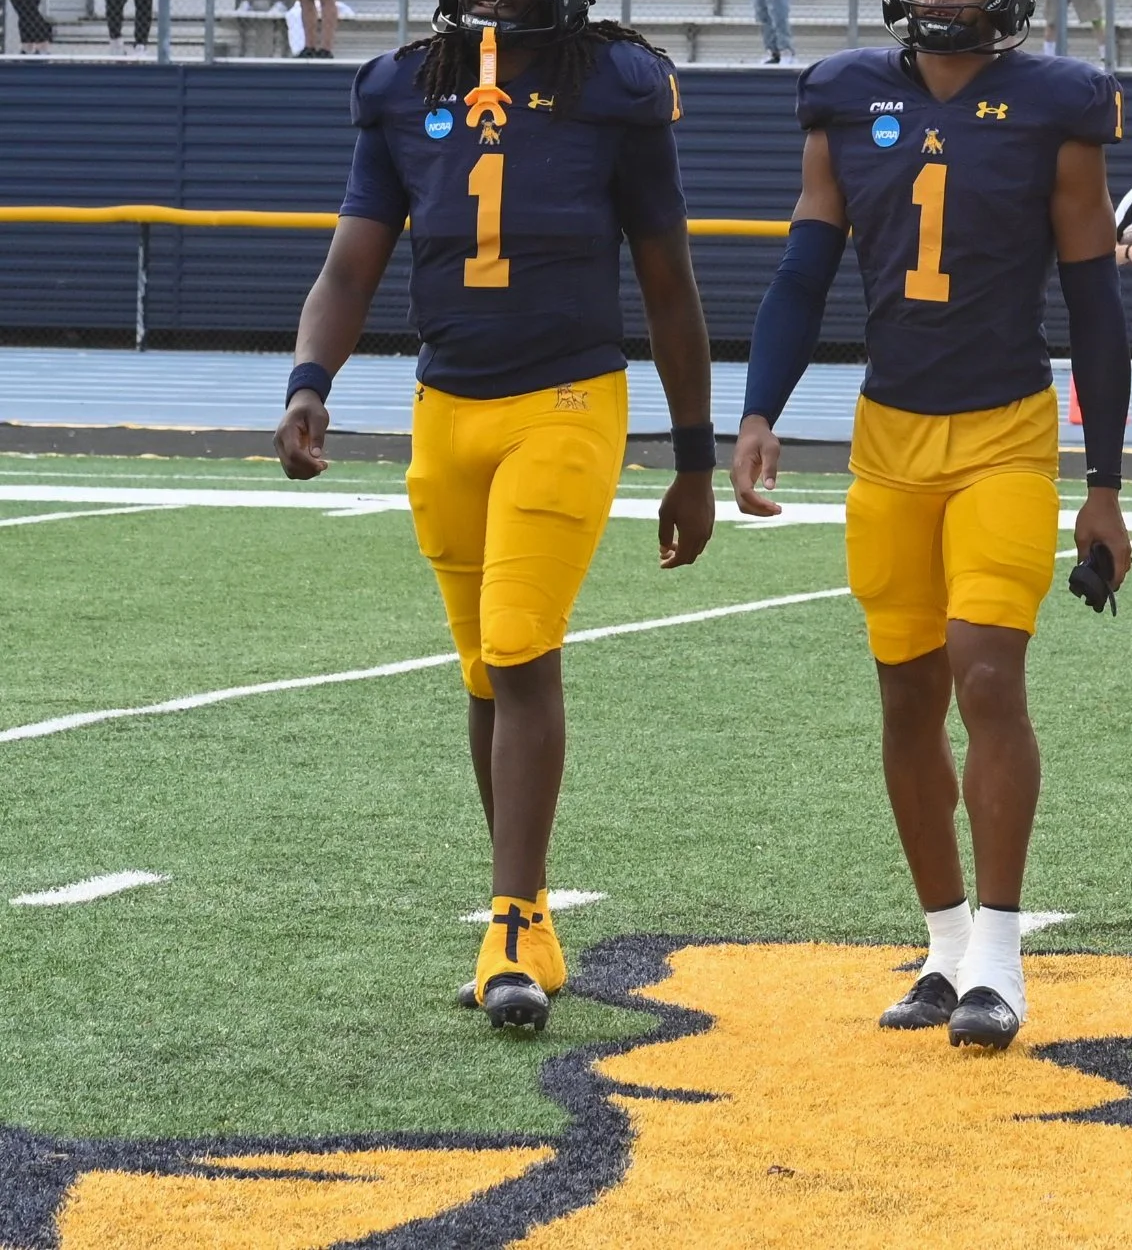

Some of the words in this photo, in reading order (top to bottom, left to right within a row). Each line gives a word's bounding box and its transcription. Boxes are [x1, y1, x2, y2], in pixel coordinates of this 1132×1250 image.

[472, 17, 497, 28] Riddell
[668, 73, 681, 121] 1
[869, 101, 904, 114] CIAA
[429, 122, 452, 133] NCAA
[1113, 91, 1124, 139] 1
[875, 130, 898, 140] NCAA
[463, 153, 510, 289] 1
[904, 163, 951, 303] 1
